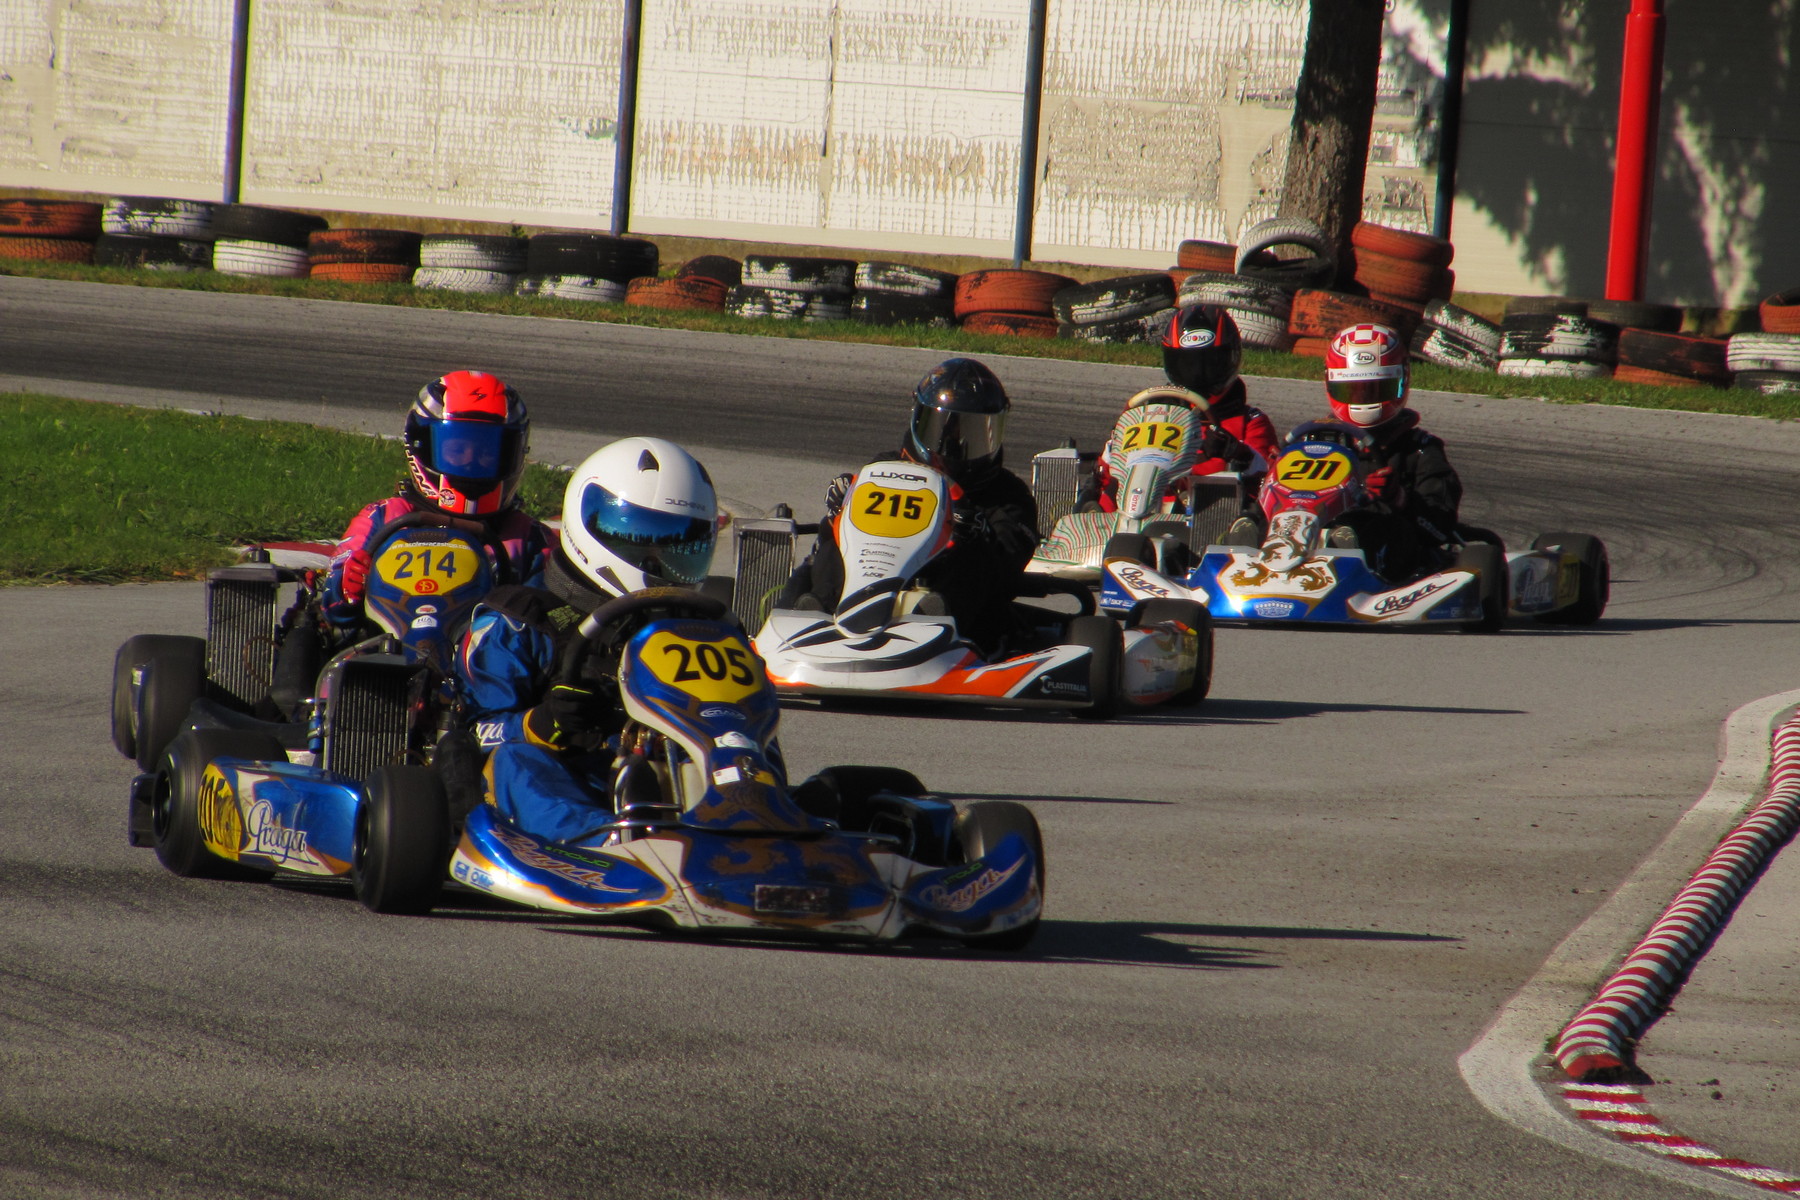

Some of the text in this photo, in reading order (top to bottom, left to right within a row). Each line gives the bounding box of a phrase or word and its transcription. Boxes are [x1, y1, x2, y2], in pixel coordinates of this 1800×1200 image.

[1122, 424, 1181, 450] 212
[870, 471, 928, 483] LUXOR
[1280, 459, 1341, 480] 211
[864, 491, 923, 520] 215
[394, 549, 457, 580] 214
[1374, 581, 1446, 614] Praga
[662, 643, 754, 686] 205
[247, 799, 313, 864] Praga
